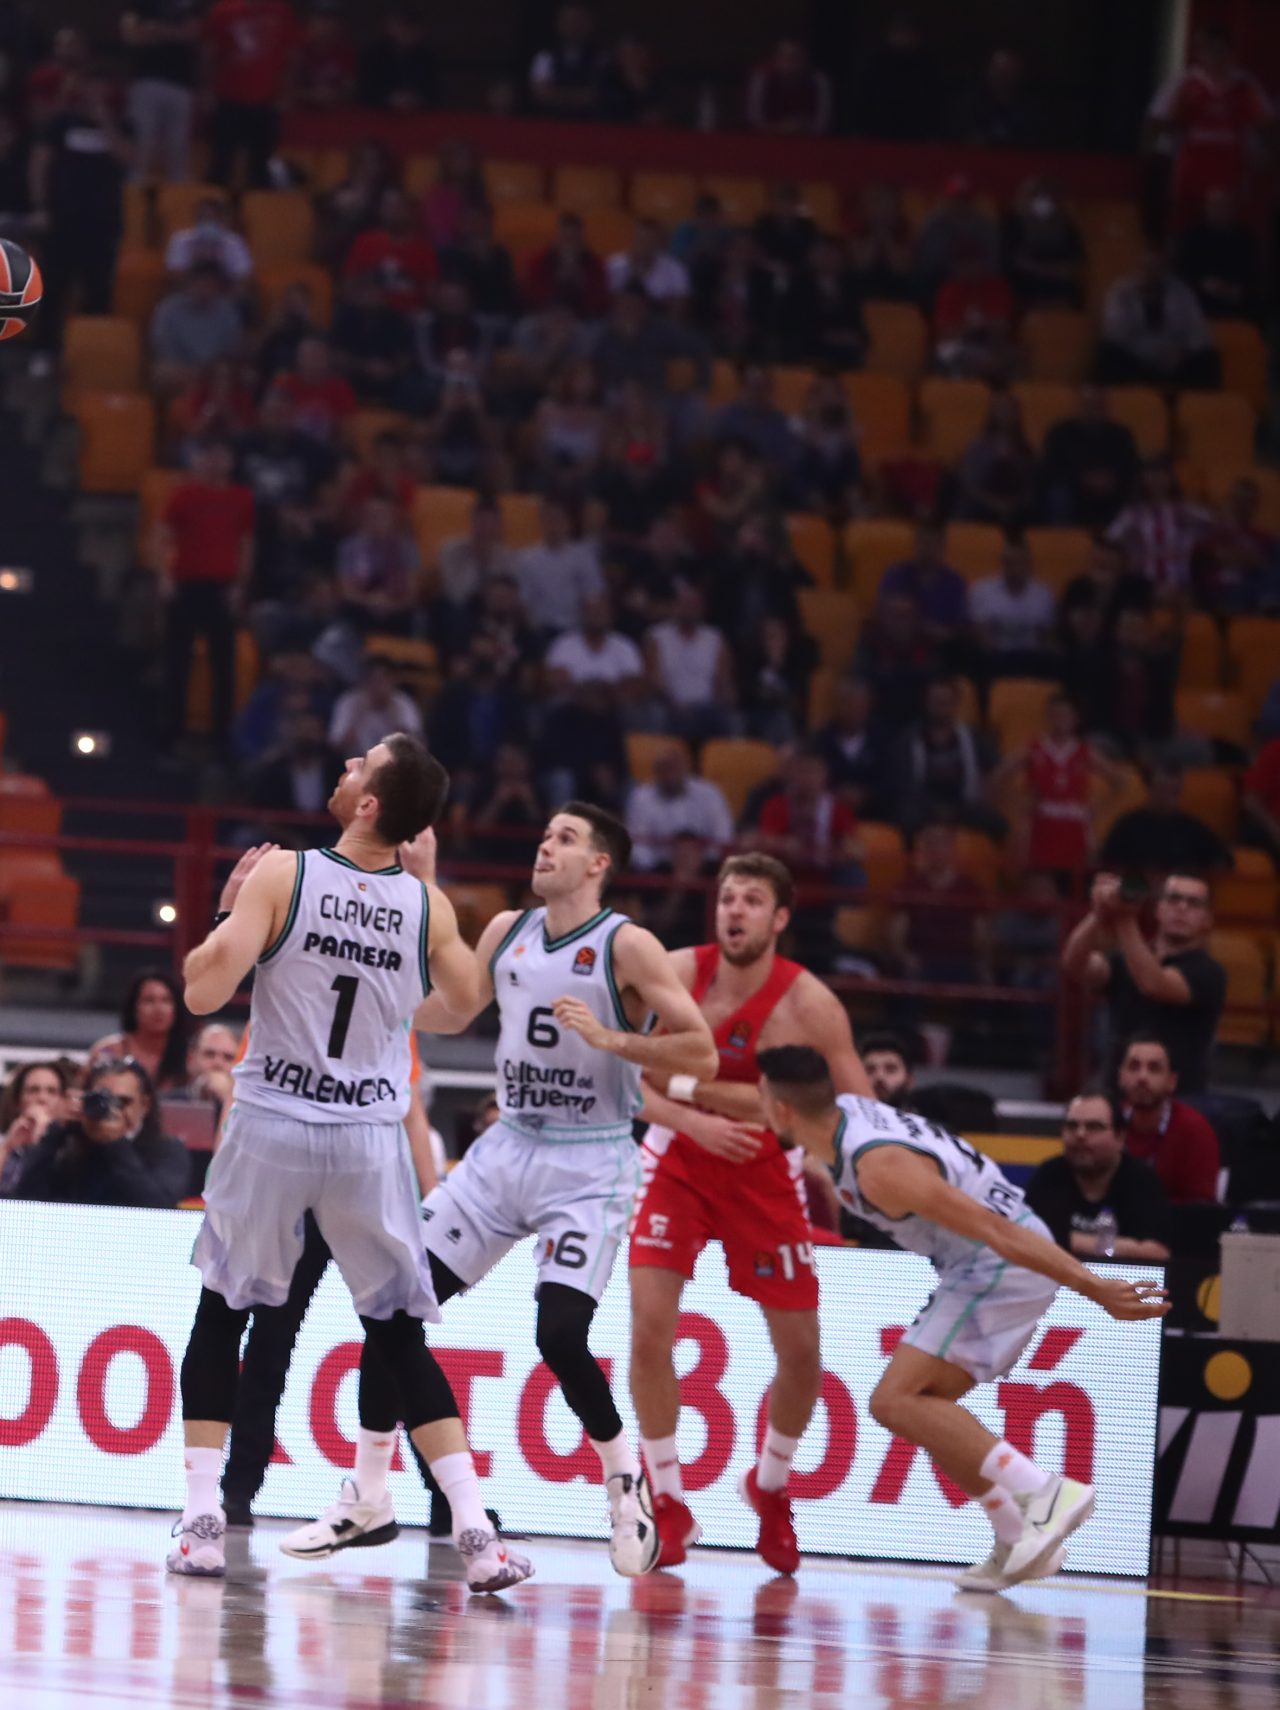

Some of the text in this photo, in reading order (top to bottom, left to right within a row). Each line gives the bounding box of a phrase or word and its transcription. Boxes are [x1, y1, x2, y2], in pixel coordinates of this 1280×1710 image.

[320, 894, 403, 935] CLAVER
[303, 932, 402, 971] PAMESA
[327, 974, 360, 1060] 1
[527, 1005, 560, 1048] 6
[264, 1055, 396, 1107] VALENCA
[554, 1230, 588, 1270] 6
